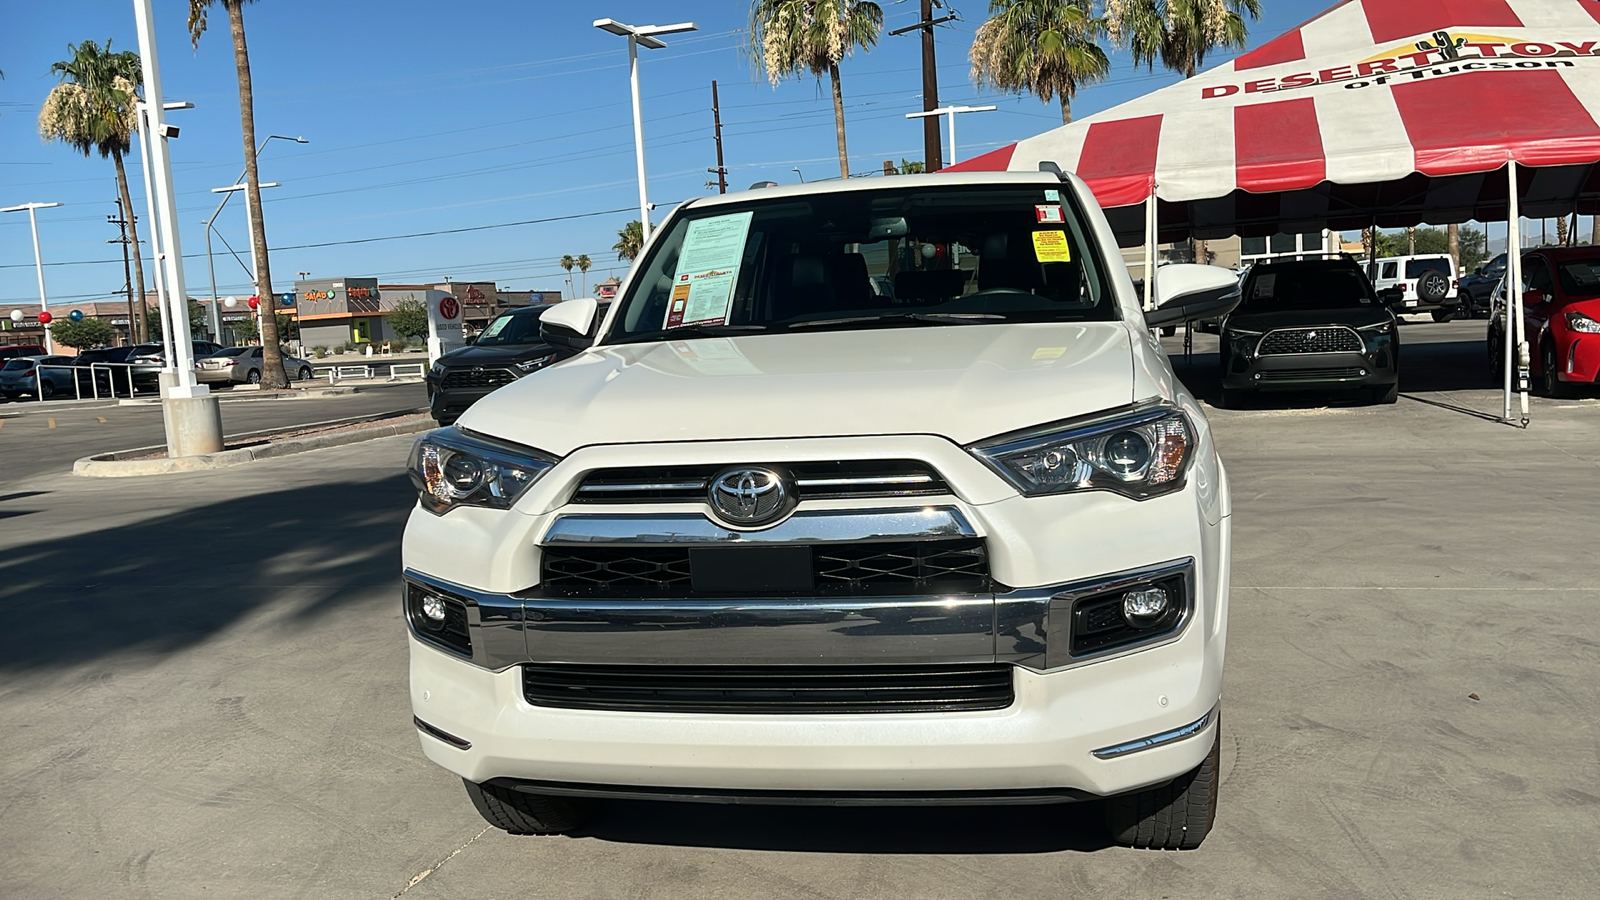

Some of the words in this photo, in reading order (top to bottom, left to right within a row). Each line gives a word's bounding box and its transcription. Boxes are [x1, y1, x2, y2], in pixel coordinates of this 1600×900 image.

[1201, 48, 1440, 99] DESERT
[1463, 41, 1598, 58] TOY
[1343, 75, 1391, 91] of
[1392, 60, 1575, 79] Tucson
